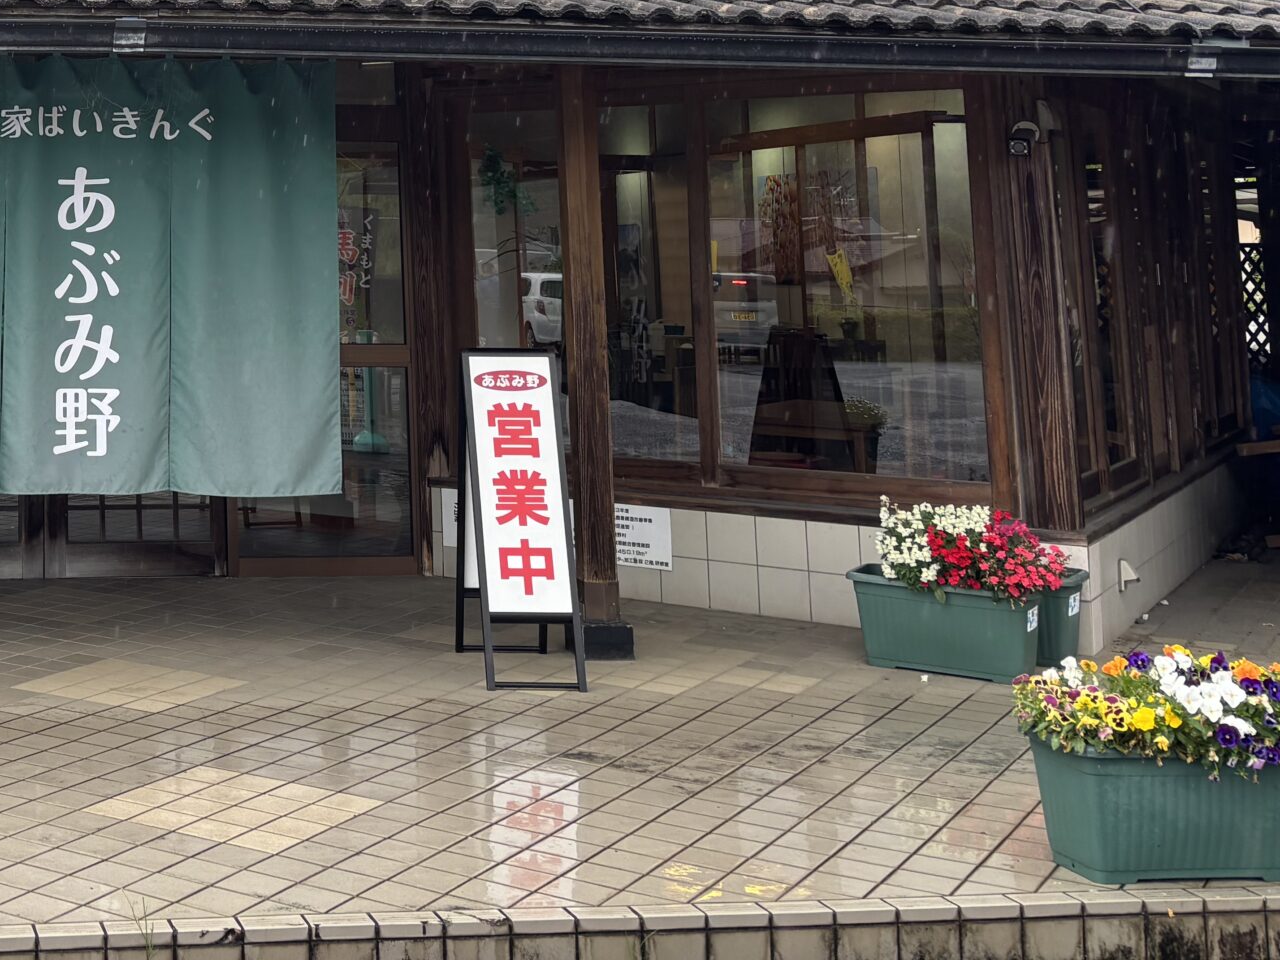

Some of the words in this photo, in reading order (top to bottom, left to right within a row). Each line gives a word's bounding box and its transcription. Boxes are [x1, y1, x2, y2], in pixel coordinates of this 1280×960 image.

[53, 167, 120, 456] あぶみ野
[360, 214, 373, 288] くまもと
[481, 374, 540, 388] あぶみ野
[487, 402, 555, 595] 営業中
